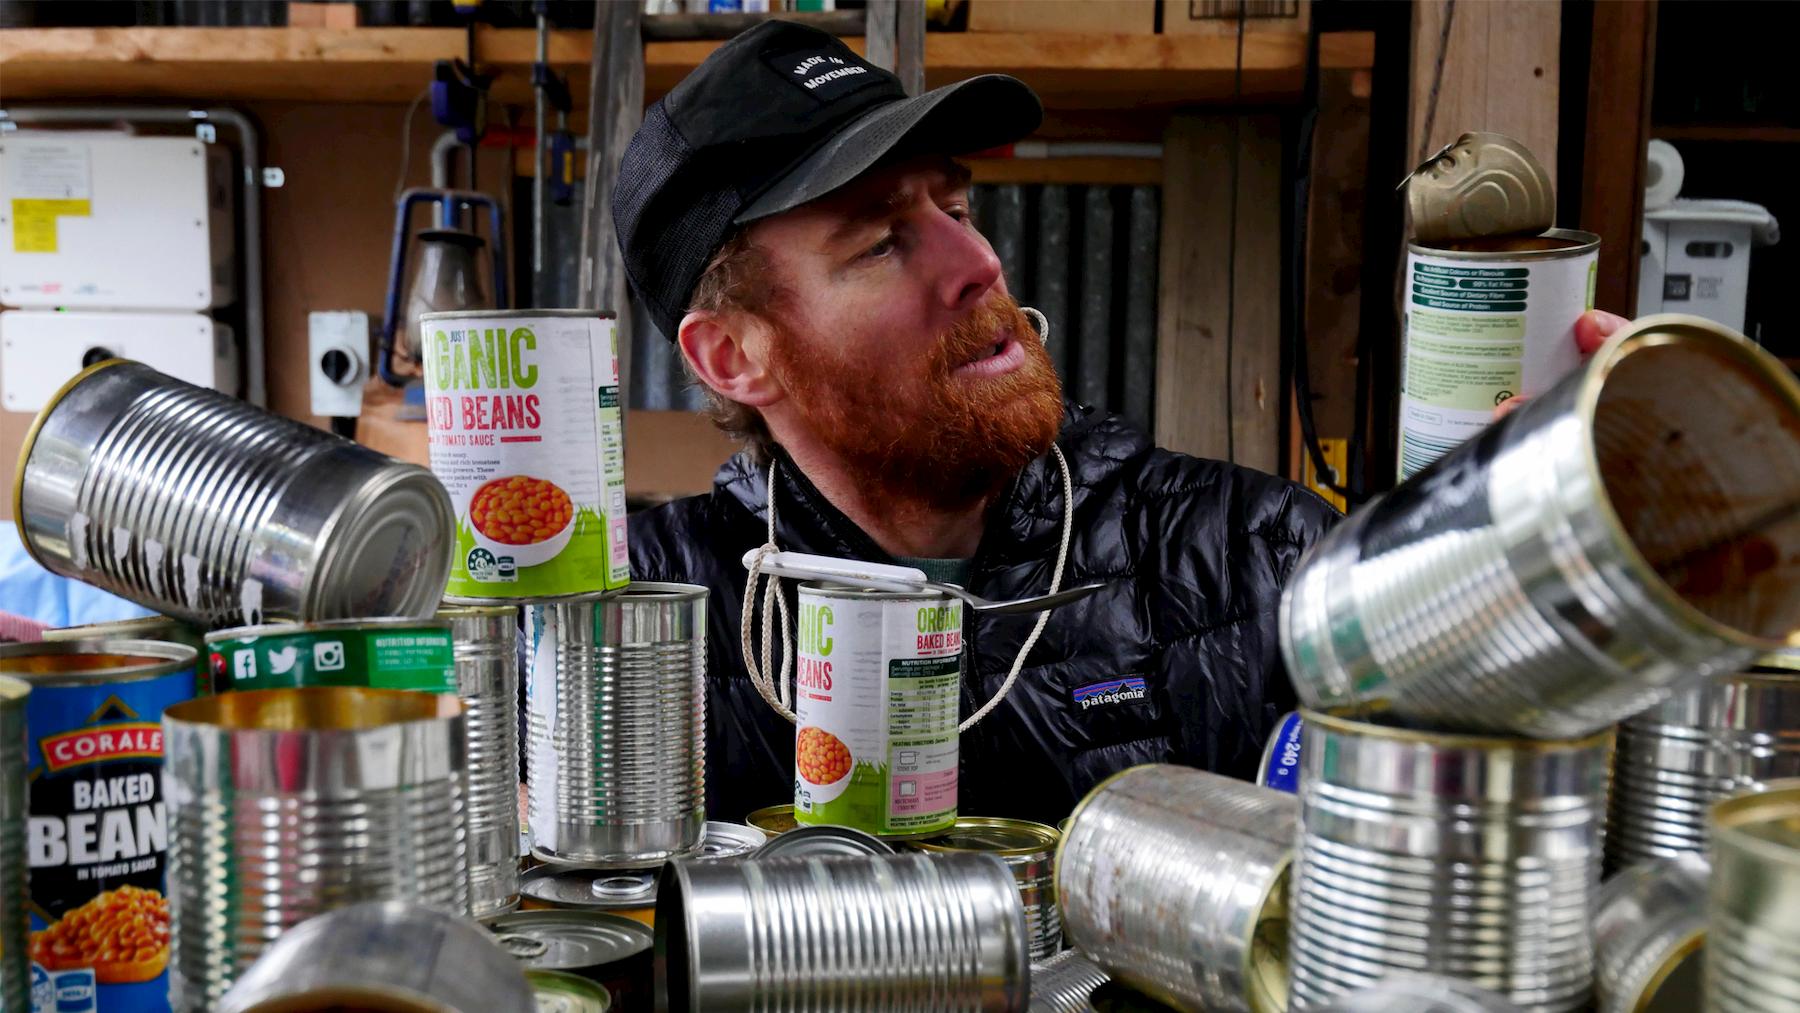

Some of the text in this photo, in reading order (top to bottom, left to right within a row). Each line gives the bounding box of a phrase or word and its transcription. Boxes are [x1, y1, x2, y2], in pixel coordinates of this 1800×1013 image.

[794, 56, 844, 75] MADE IN
[804, 66, 867, 89] MOVEMBER
[450, 330, 466, 342] JUST
[461, 394, 542, 430] BEANS
[442, 435, 466, 446] TOMATO
[470, 434, 496, 446] SAUCE
[917, 634, 944, 650] BAKED
[1081, 689, 1145, 710] patagonia
[55, 732, 163, 760] CORALE
[1281, 742, 1301, 766] 240
[1277, 768, 1289, 776] g
[73, 772, 155, 810] BAKED
[28, 801, 168, 868] BEAN
[77, 856, 156, 880] IN TOMATO SAUCE
